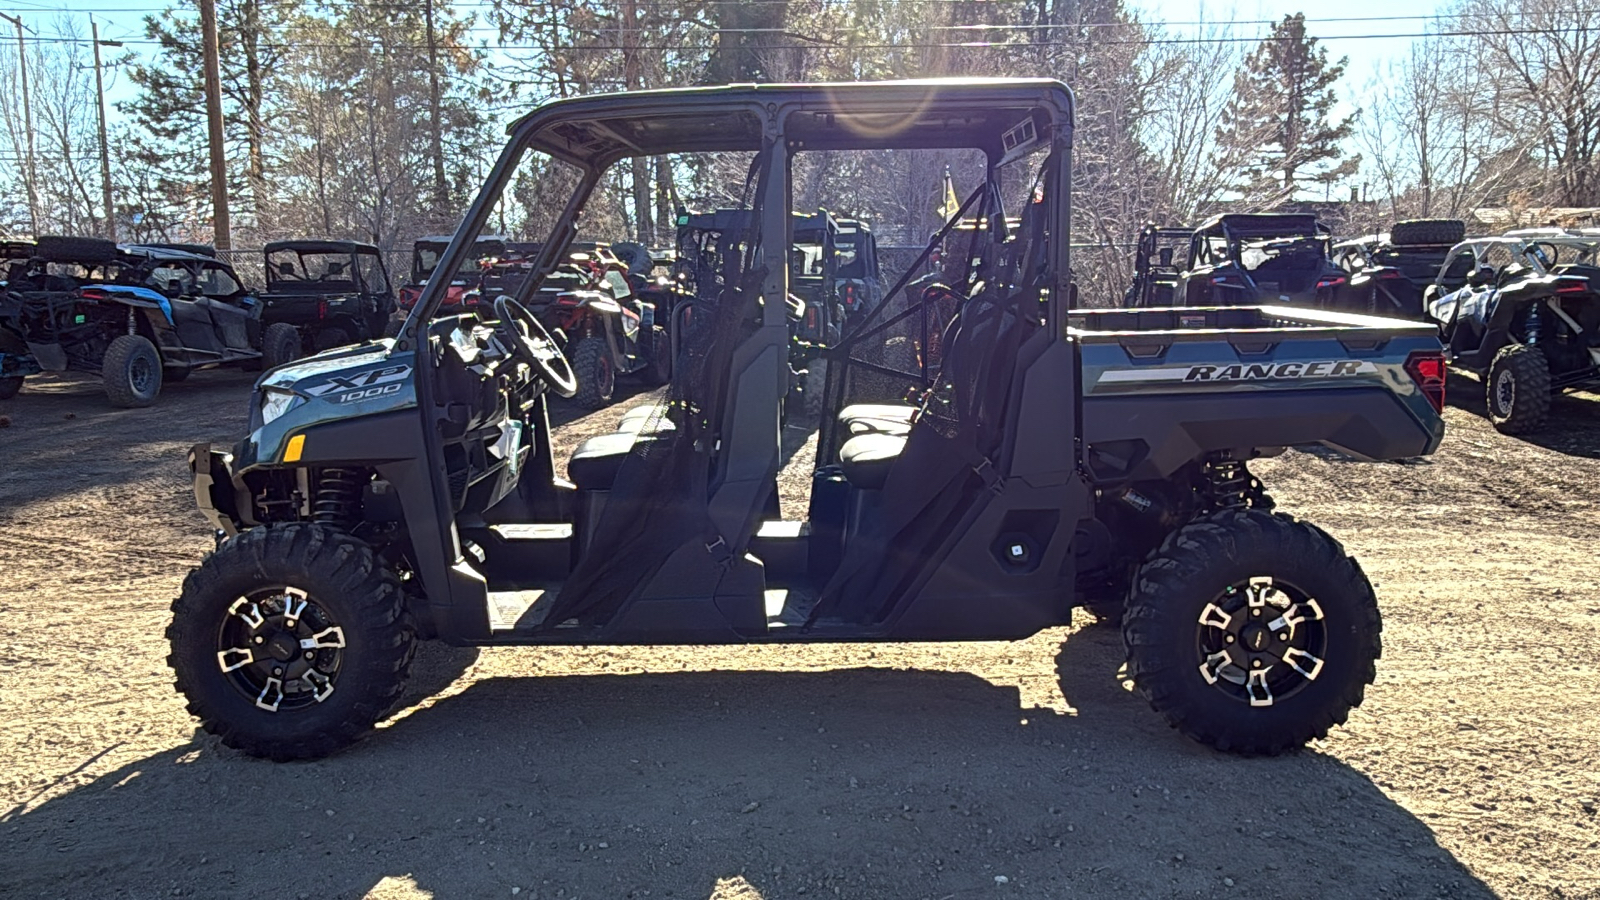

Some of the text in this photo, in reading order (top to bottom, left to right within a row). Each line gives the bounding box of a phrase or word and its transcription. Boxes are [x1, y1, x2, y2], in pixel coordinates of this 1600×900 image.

[319, 364, 409, 396] XP
[1184, 360, 1363, 382] RANGER
[340, 383, 402, 403] 1000
